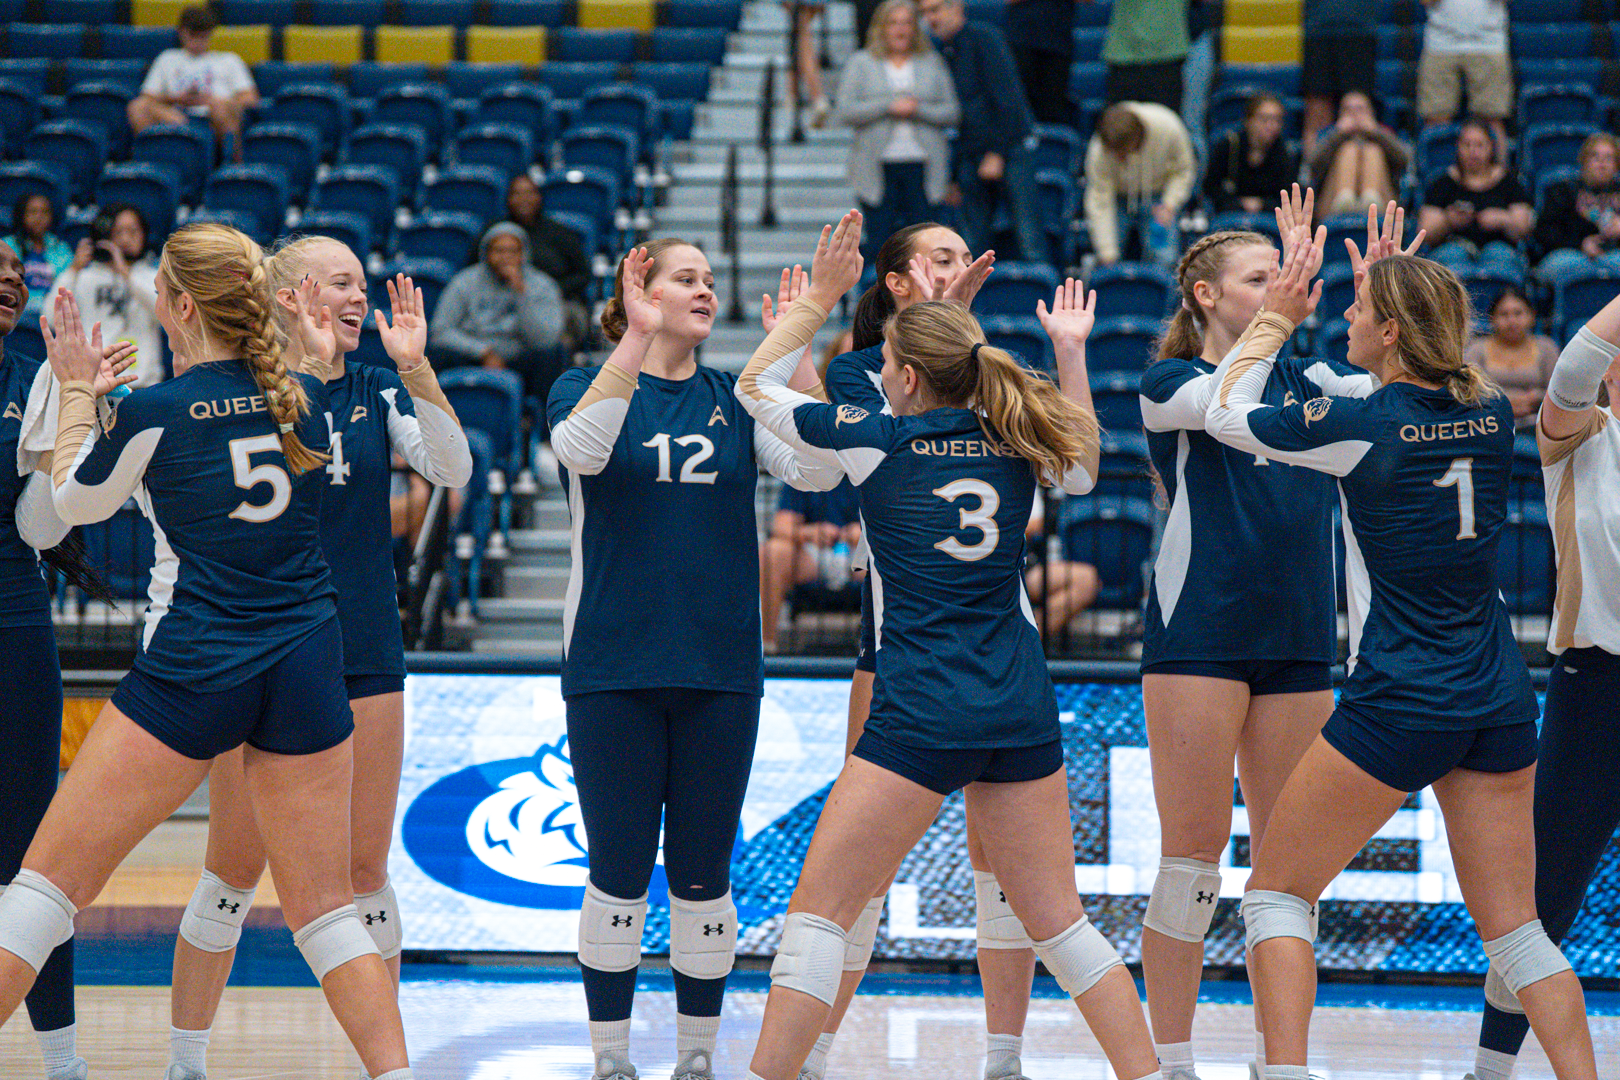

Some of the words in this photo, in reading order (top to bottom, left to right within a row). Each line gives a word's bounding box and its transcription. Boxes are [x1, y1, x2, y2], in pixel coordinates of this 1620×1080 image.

[189, 395, 268, 420] QUEE
[1399, 416, 1499, 443] QUEENS
[228, 432, 292, 523] 5
[642, 432, 719, 485] 12
[931, 477, 1001, 562] 3
[1432, 457, 1478, 541] 1
